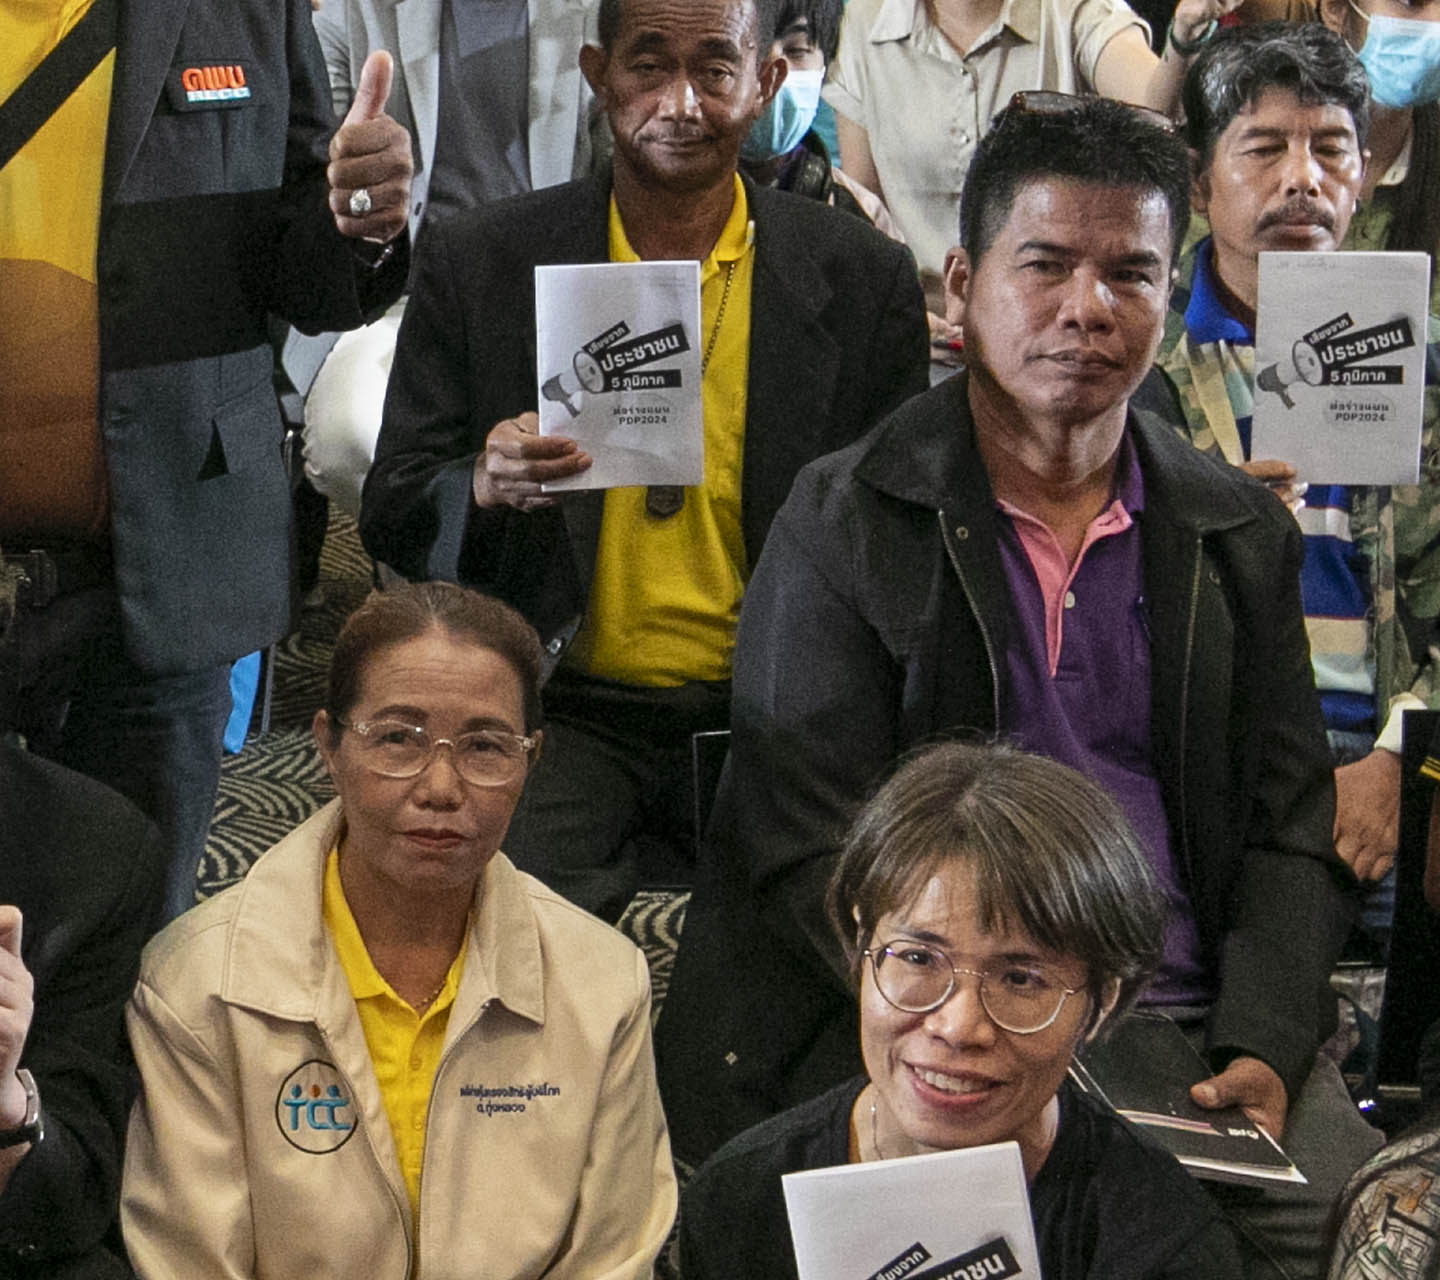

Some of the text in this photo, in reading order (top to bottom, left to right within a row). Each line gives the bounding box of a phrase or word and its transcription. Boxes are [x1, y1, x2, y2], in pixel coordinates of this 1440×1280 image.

[588, 327, 626, 354] เสียงจาก
[1309, 319, 1349, 344] เสียงจาก
[601, 334, 680, 372] ประชาชน
[1321, 329, 1404, 364] ประชาชน
[623, 375, 665, 390] ภูมิภาค
[1342, 370, 1386, 385] ภูมิภาค
[619, 415, 667, 426] PDP2024
[1336, 413, 1385, 422] PDP2024
